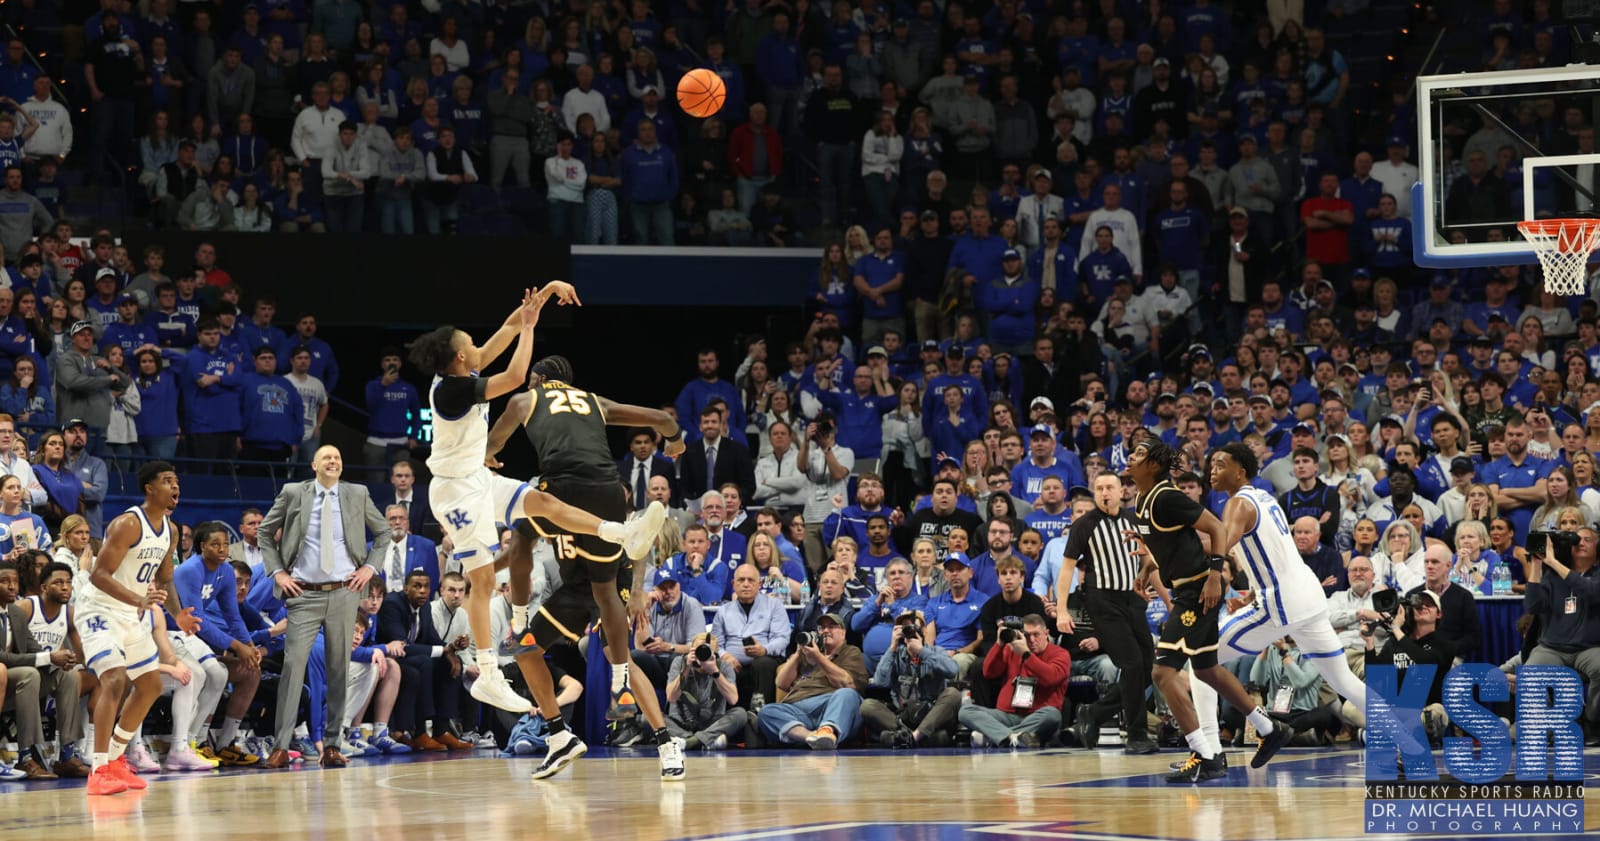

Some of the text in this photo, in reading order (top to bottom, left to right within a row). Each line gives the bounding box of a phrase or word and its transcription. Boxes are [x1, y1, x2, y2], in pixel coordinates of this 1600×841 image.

[1092, 264, 1112, 281] UK
[544, 389, 592, 416] 25
[444, 508, 473, 531] UK
[136, 546, 167, 560] KENTUC
[556, 534, 578, 561] 15
[86, 615, 109, 633] UK
